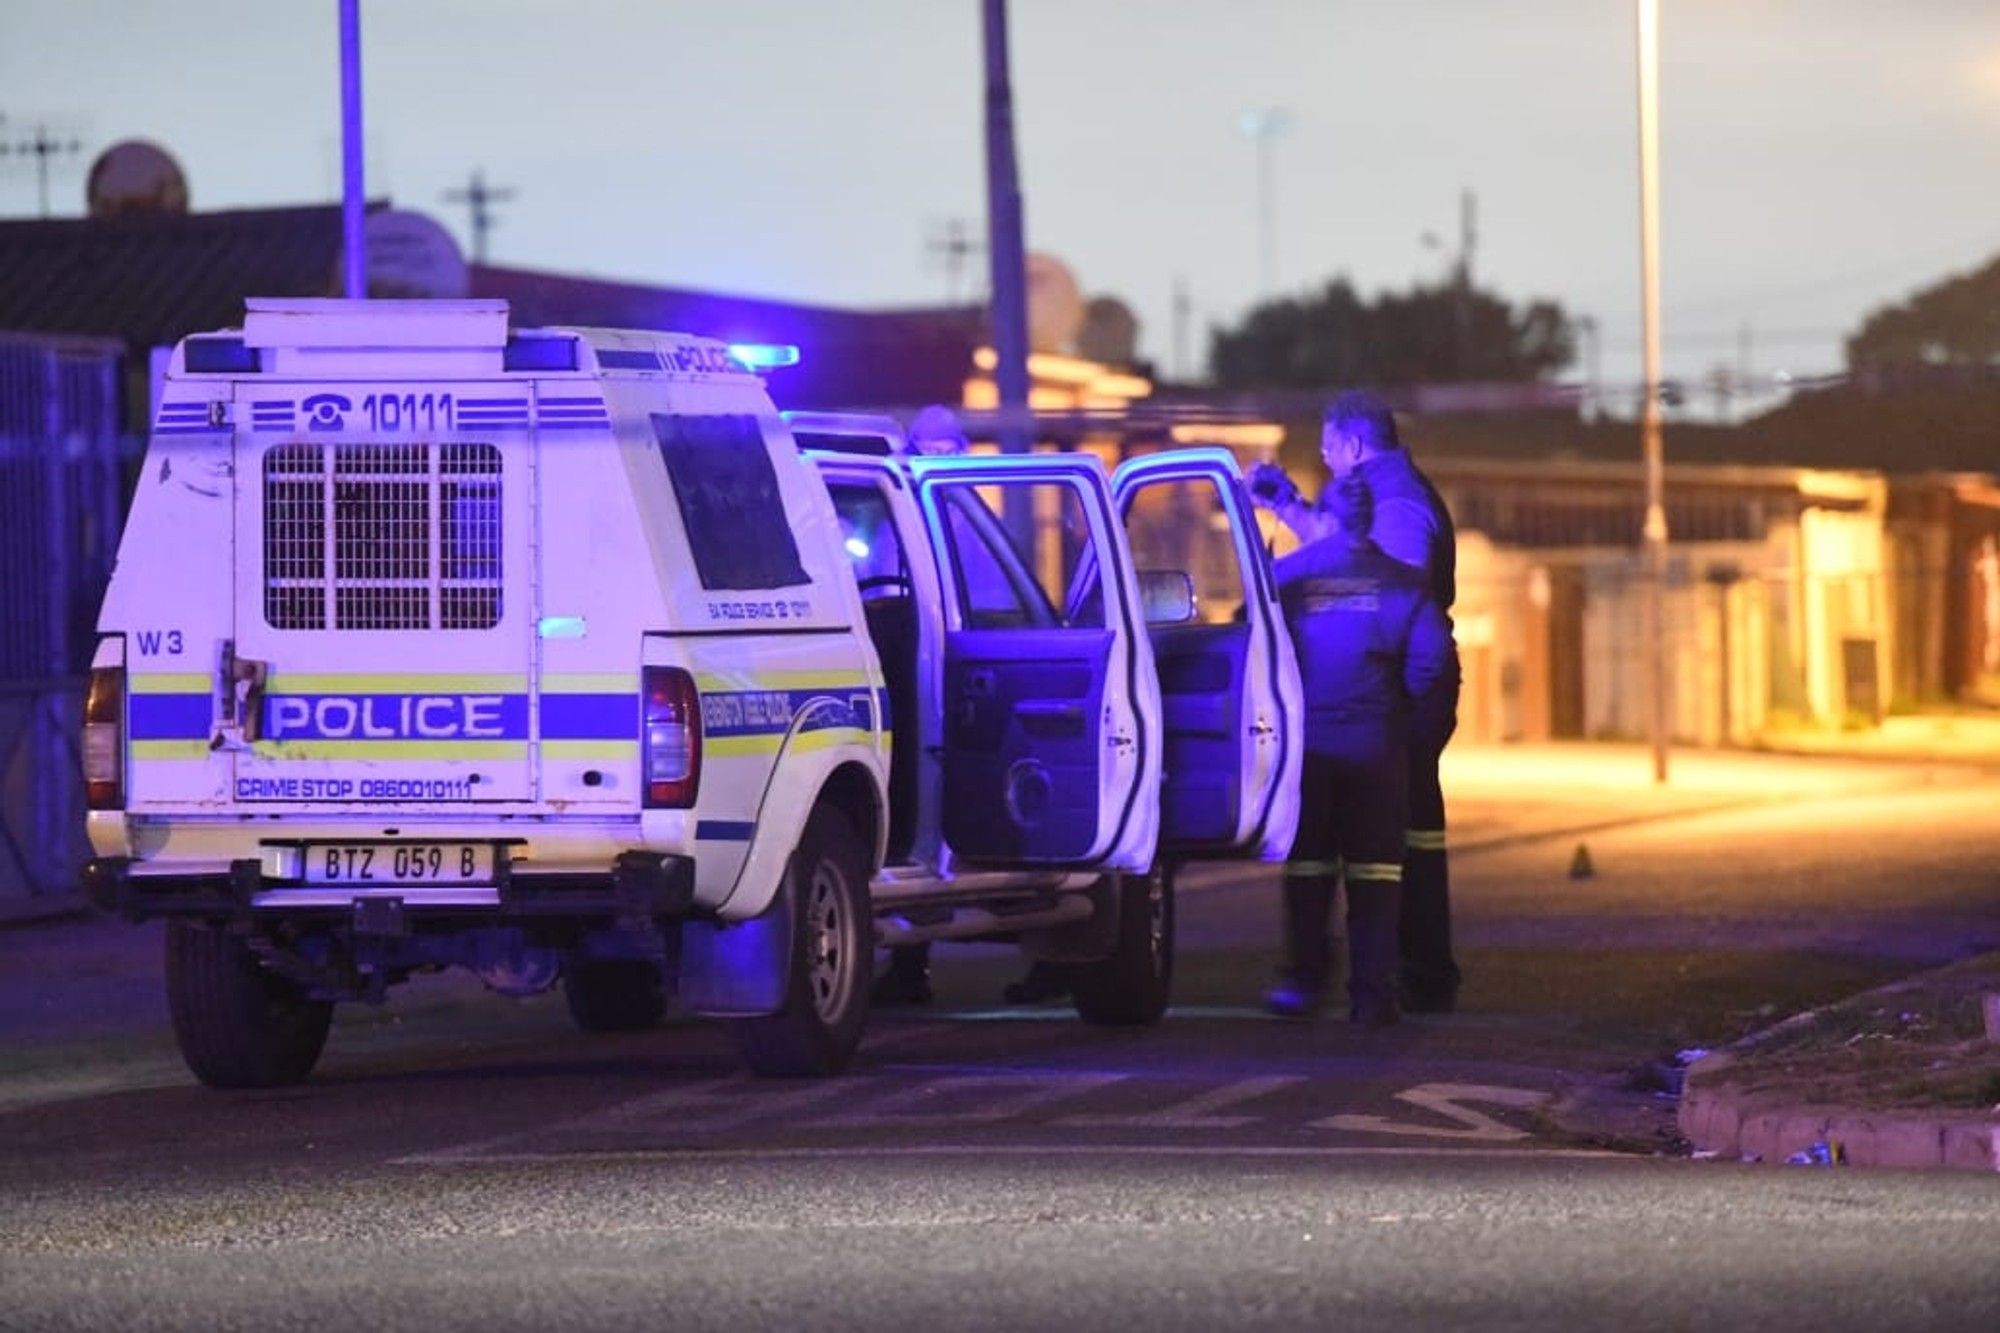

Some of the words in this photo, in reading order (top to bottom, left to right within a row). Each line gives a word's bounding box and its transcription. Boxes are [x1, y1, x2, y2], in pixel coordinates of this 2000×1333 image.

[362, 393, 453, 433] 10111
[137, 630, 162, 656] W
[168, 630, 183, 655] 3
[270, 696, 504, 738] POLICE
[236, 778, 299, 798] CRIME
[302, 779, 353, 798] STOP
[359, 778, 471, 799] 0860010111
[325, 848, 374, 880] BTZ
[394, 847, 442, 878] 059
[460, 847, 475, 877] B
